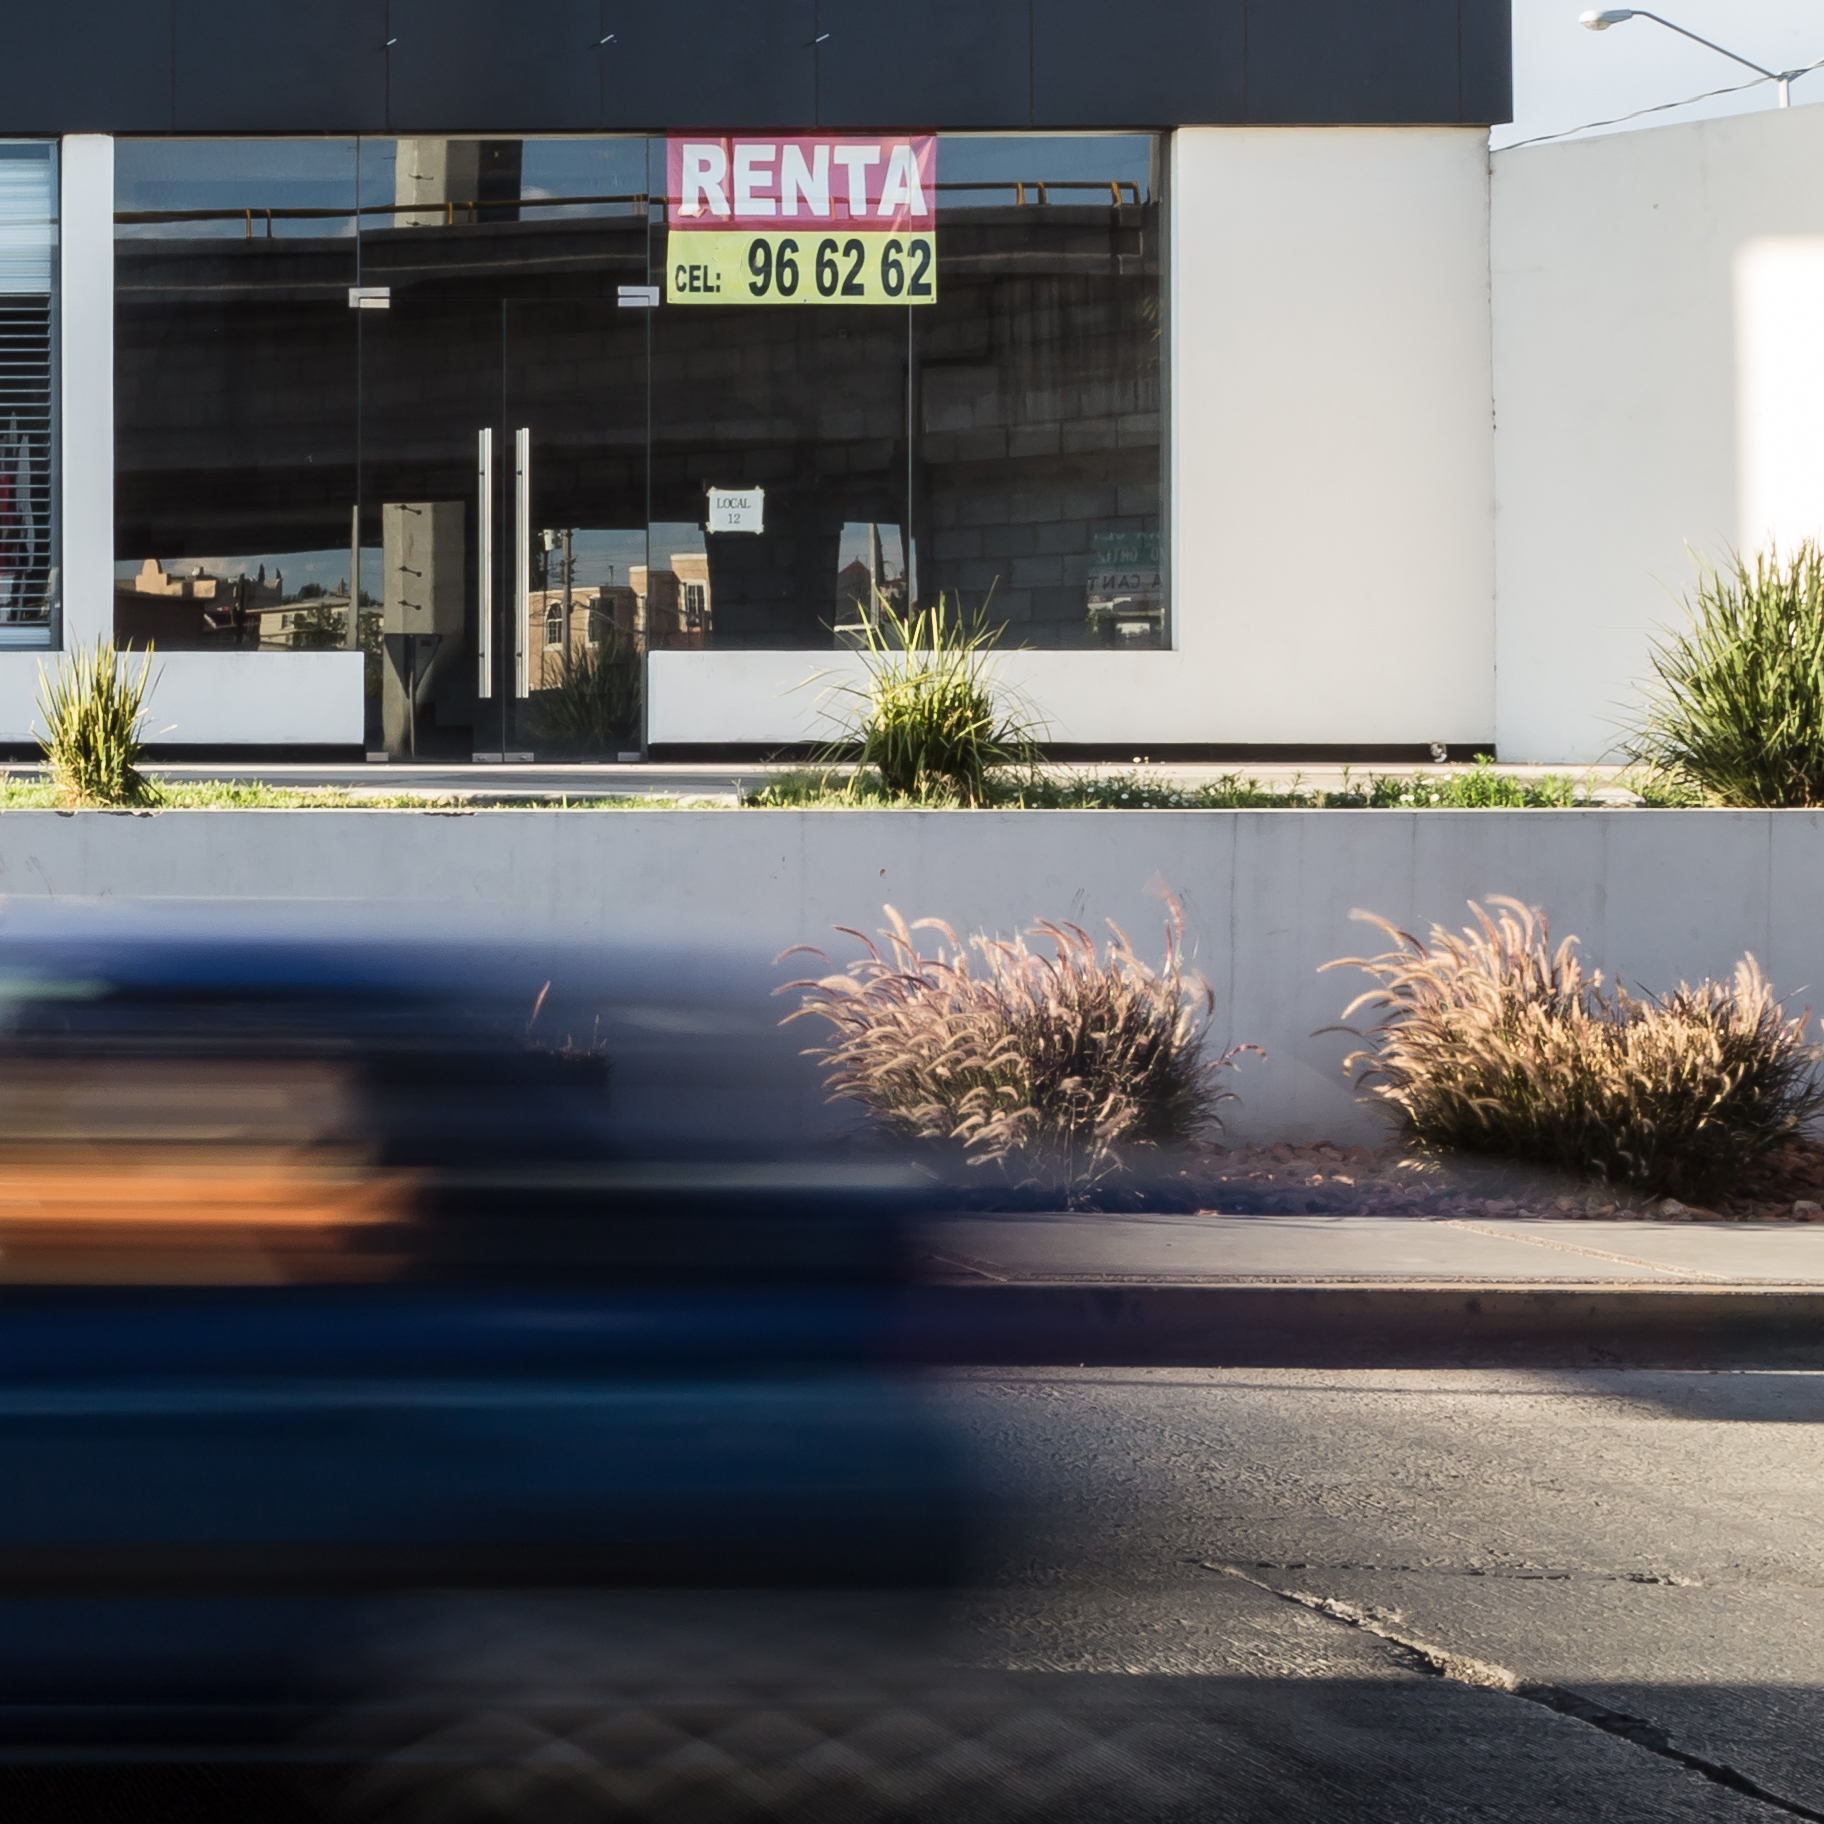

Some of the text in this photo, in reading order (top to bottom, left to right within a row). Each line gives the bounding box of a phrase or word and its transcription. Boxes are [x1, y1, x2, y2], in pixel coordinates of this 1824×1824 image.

[678, 144, 928, 217] RENTA
[675, 238, 932, 297] CEL: 96 62 62
[717, 498, 751, 509] LOCAL
[728, 513, 741, 524] 12
